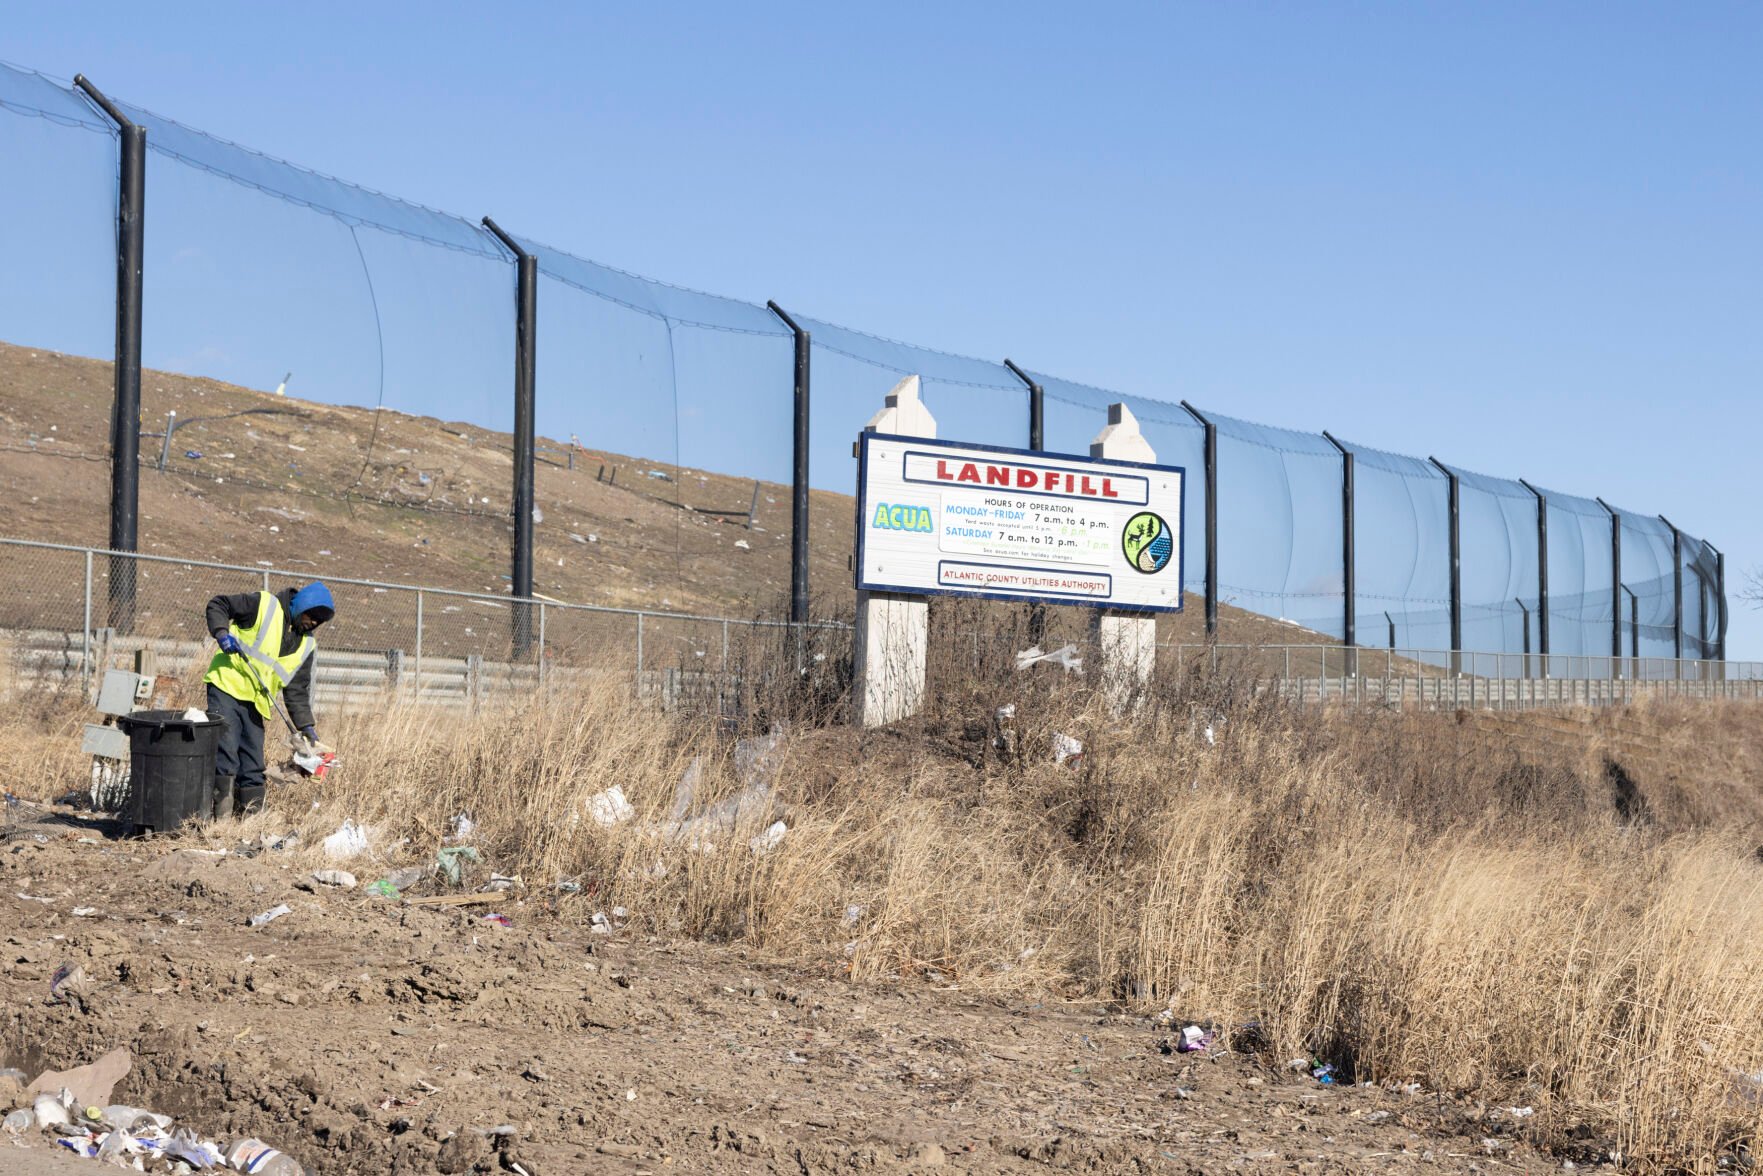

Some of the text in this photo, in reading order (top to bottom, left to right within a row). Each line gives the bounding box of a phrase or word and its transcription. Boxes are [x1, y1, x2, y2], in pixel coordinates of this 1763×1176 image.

[936, 460, 1118, 498] LANDFILL
[984, 498, 1074, 513] HOURS OF OPERATION
[872, 502, 933, 533] ACUA
[946, 505, 1110, 529] MONDAY-FRIDAY 7 a.m. to 4 p.m.
[946, 526, 1078, 547] SATURDAY 7 a.m. to 12 p.m.
[943, 570, 1106, 591] ATLANTIC COUNTY UTILITIES AUTHORITY
